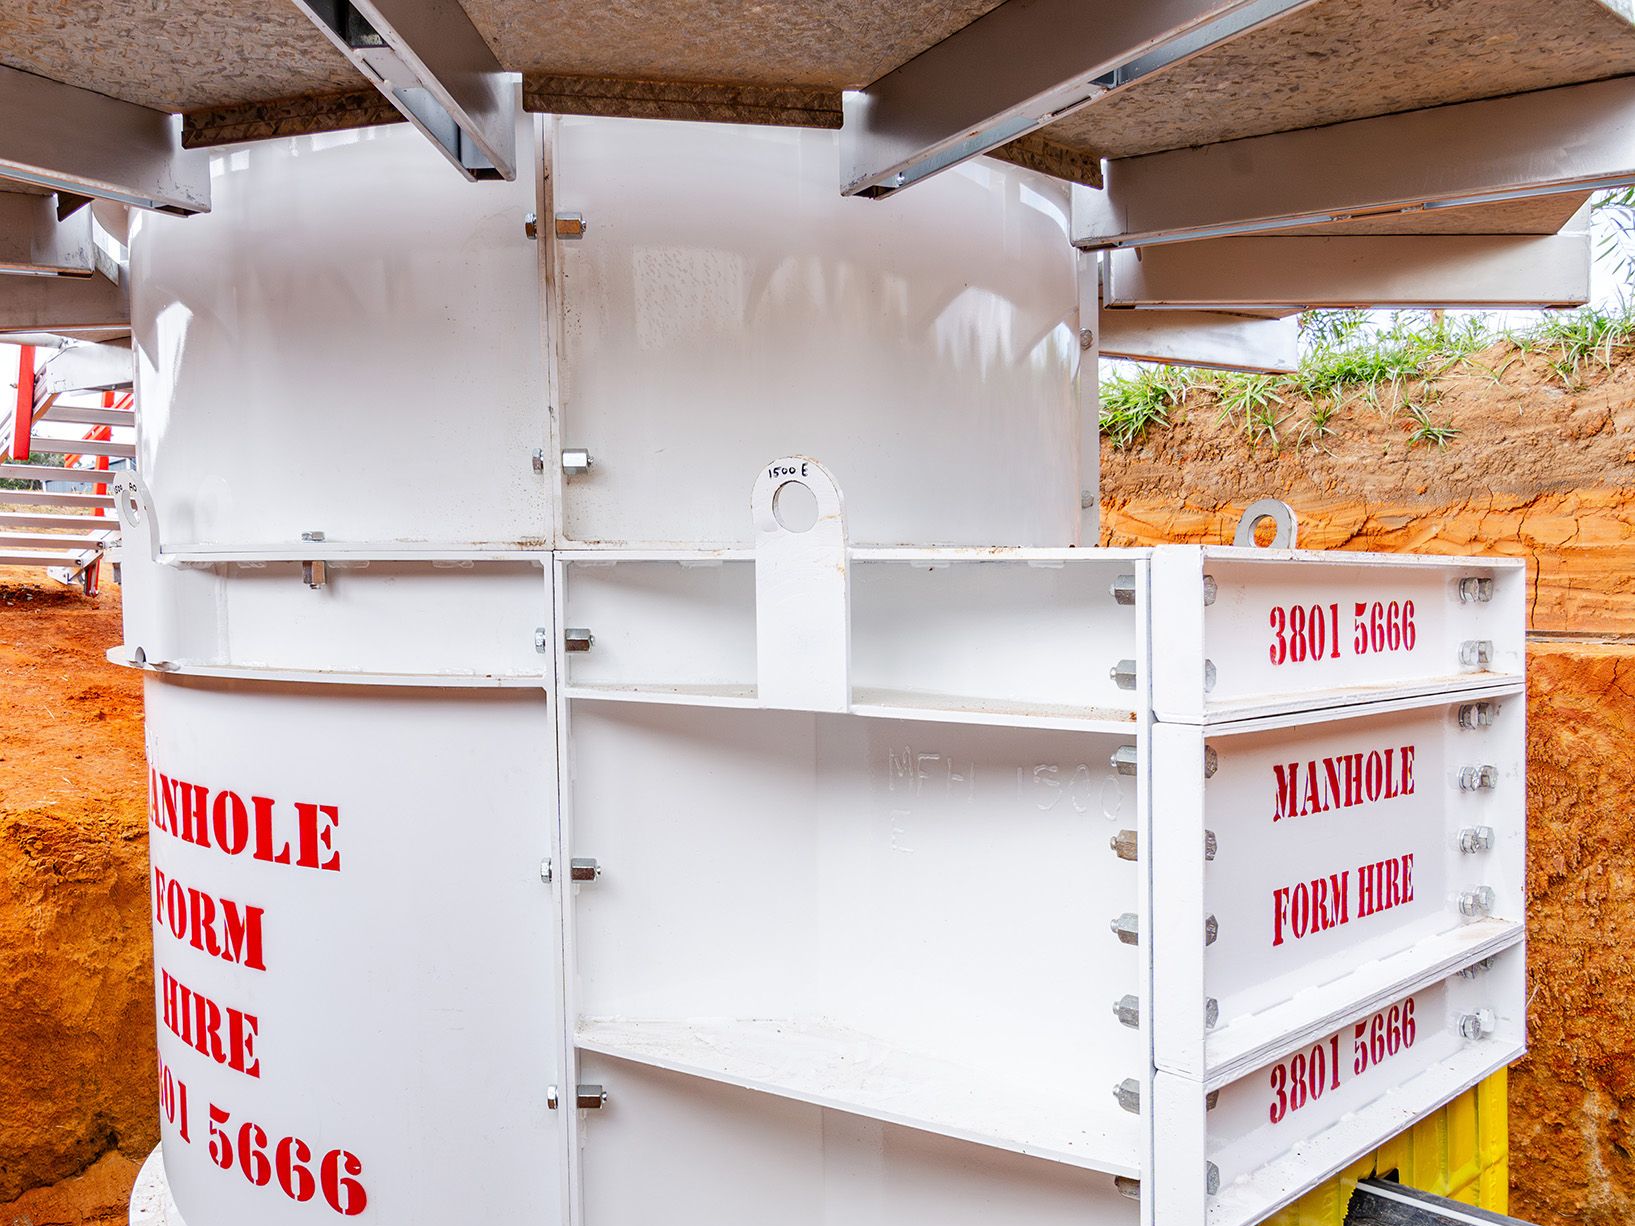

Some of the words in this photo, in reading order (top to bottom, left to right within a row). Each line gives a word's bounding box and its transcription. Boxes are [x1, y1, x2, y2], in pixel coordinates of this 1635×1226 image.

[768, 466, 796, 478] 1500
[801, 462, 809, 477] E
[1269, 603, 1341, 666] 3801
[1354, 600, 1415, 657] 5666
[149, 768, 340, 872] ANHOLE
[1273, 744, 1416, 822] MANHOLE
[154, 866, 268, 973] FORM
[1273, 870, 1349, 946] FORM
[1357, 853, 1415, 919] HIRE
[161, 968, 260, 1079] HIRE
[1269, 1034, 1341, 1125] 3801
[1353, 997, 1416, 1077] 5666
[208, 1102, 368, 1217] 5666
